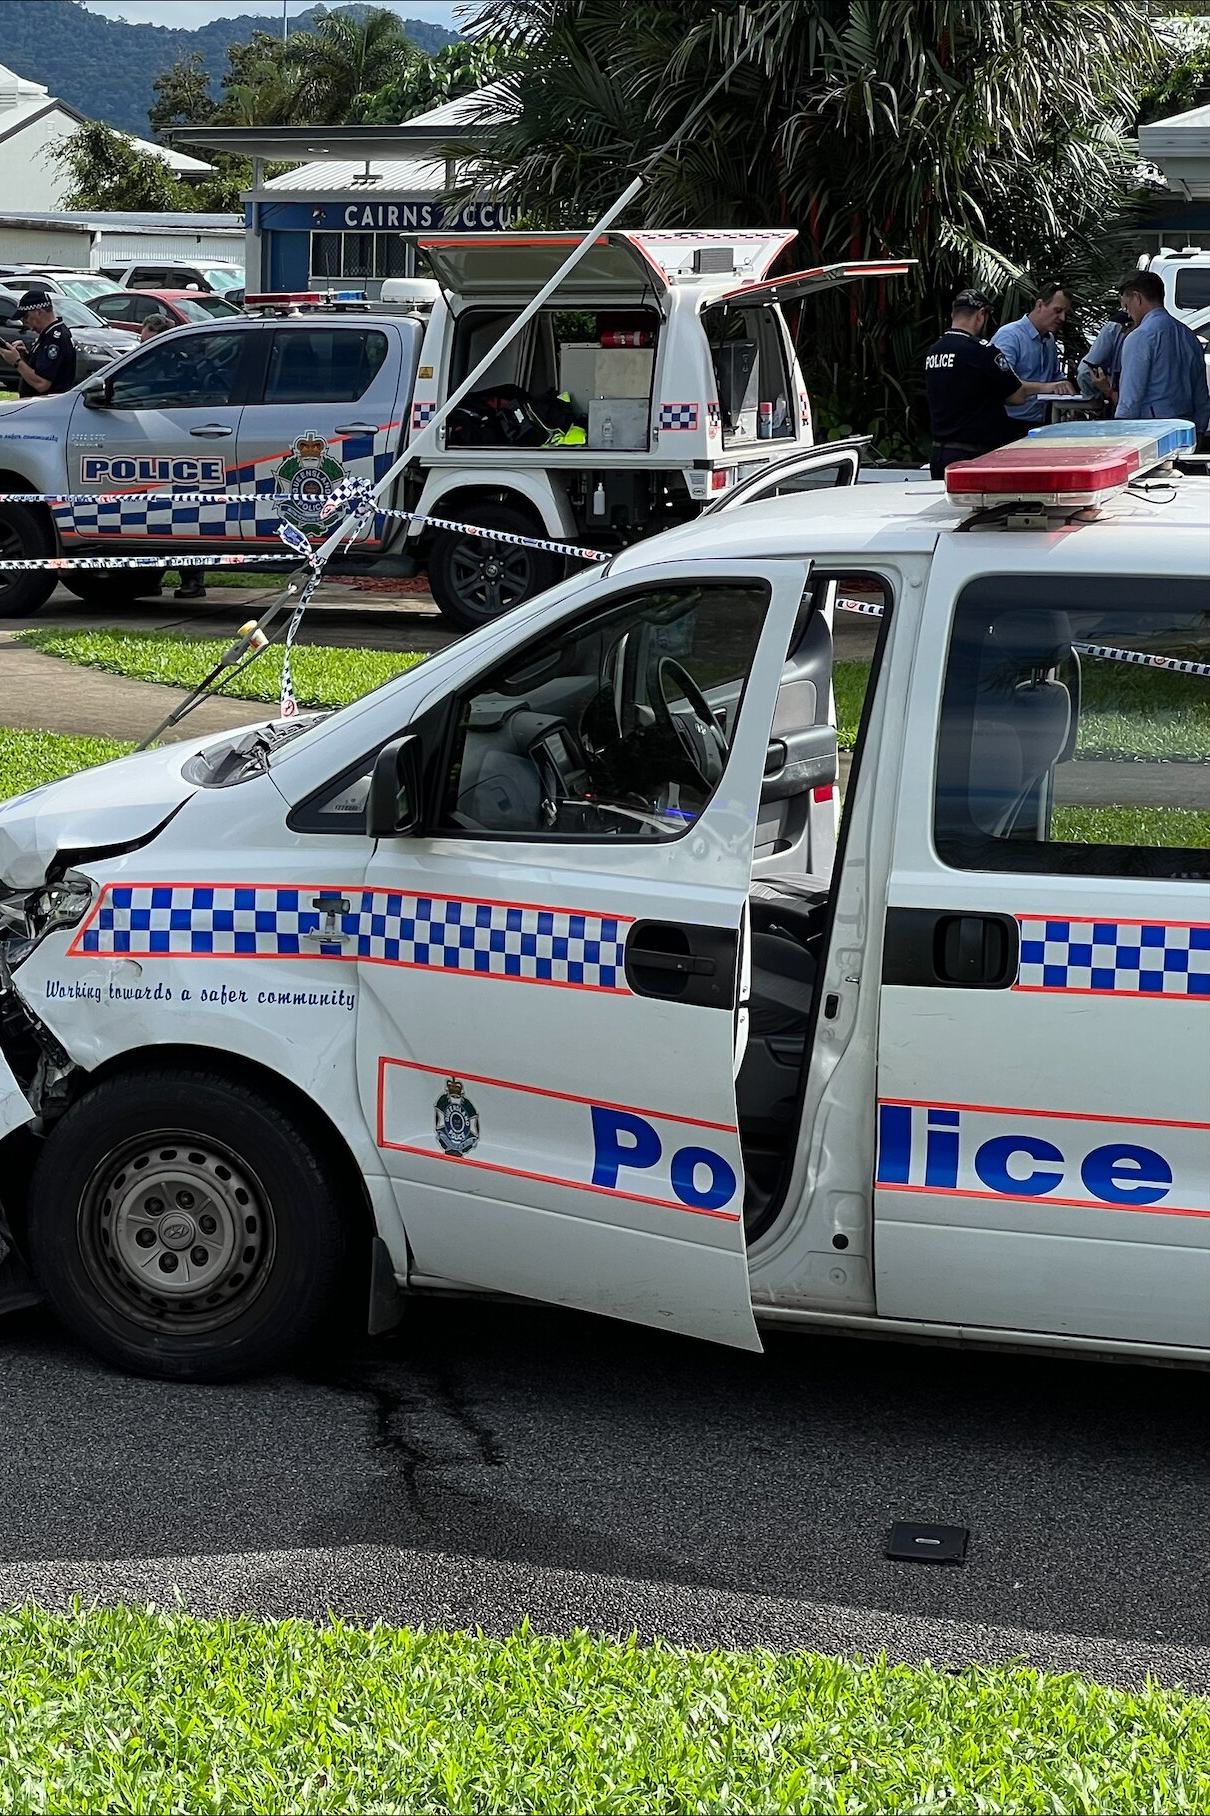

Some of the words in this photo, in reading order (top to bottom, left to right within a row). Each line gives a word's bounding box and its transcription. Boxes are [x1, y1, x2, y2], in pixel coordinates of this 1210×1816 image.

[344, 205, 432, 227] CAIRNS
[925, 353, 955, 370] POLICE
[84, 458, 222, 482] POLICE
[46, 980, 101, 1003] Working
[109, 983, 172, 1001] towards
[181, 988, 192, 1001] a
[200, 985, 248, 1005] safer
[257, 989, 356, 1011] community
